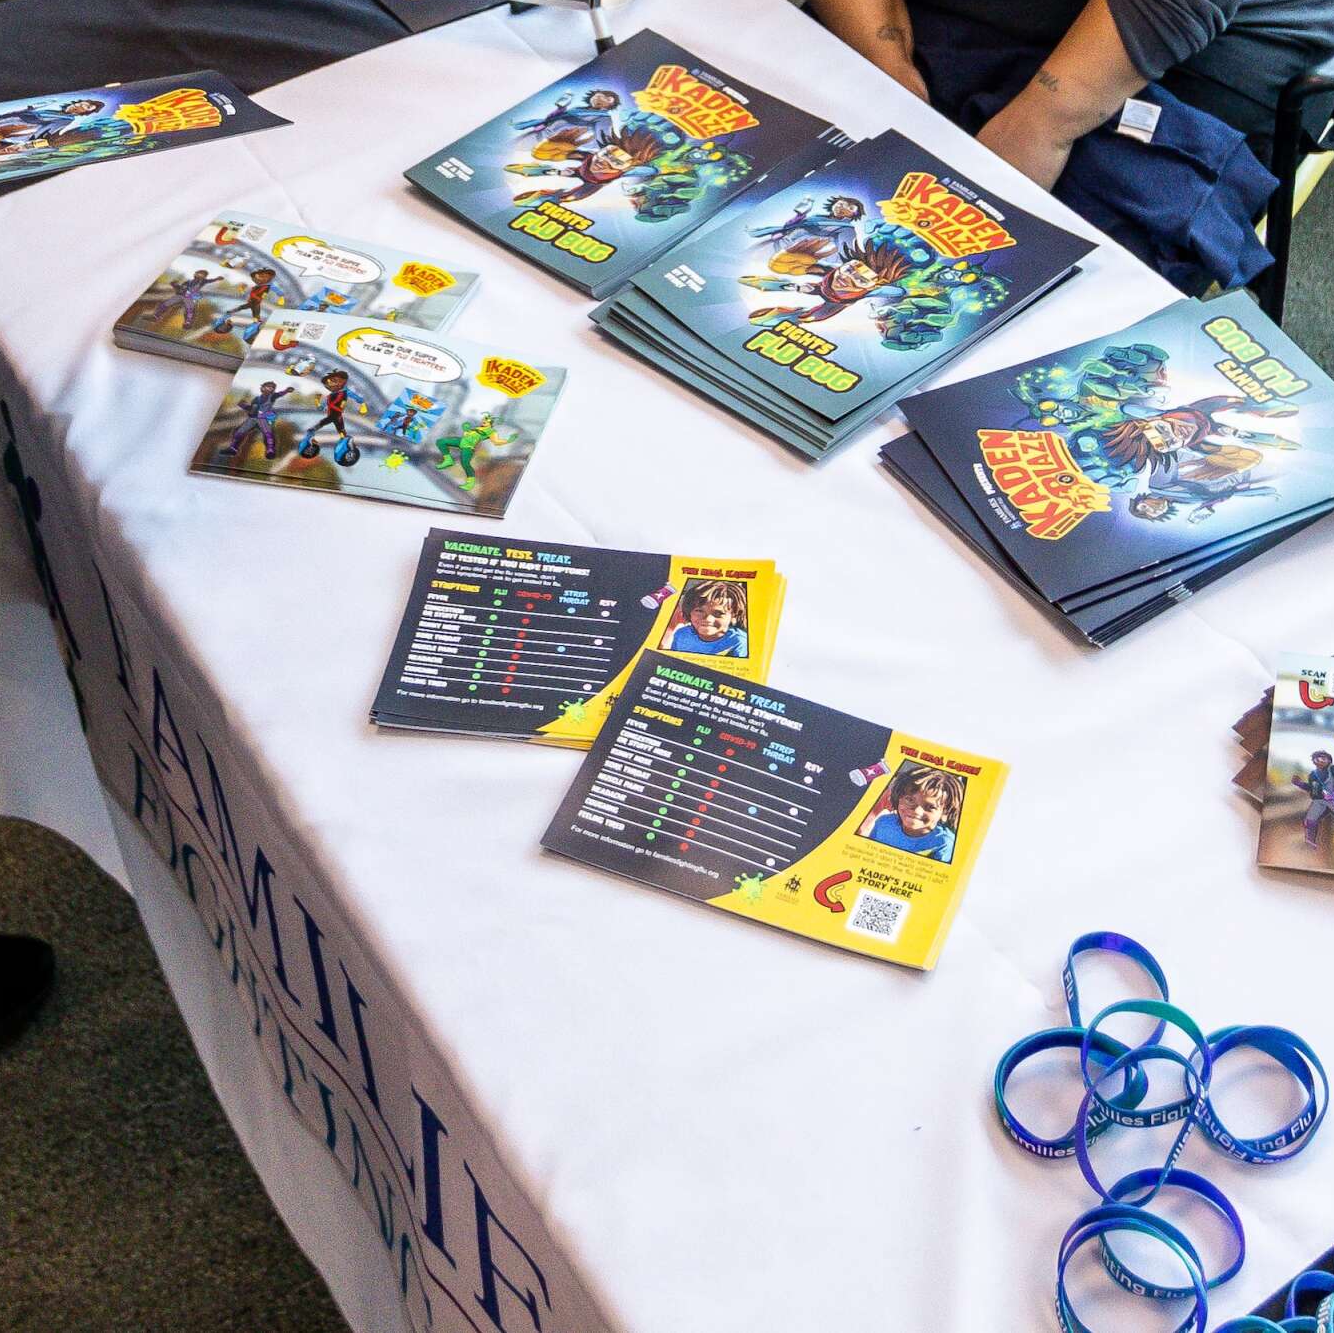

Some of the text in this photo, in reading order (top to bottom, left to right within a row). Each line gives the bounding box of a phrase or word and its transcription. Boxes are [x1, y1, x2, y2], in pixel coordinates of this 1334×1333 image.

[665, 67, 760, 132] KADEN
[670, 94, 728, 139] BLAZE
[538, 202, 594, 231] FIGHTS
[911, 175, 1015, 248] KADEN
[510, 213, 615, 262] FLU BUG
[919, 212, 985, 259] BLAZE
[408, 265, 447, 288] KADEN
[775, 322, 836, 356] FIGHTS
[1205, 318, 1308, 397] FLU BUG
[492, 360, 538, 388] KADEN
[748, 332, 860, 392] FLU BUG
[1216, 360, 1269, 403] FIGHTS
[979, 431, 1074, 536] KADEN
[1018, 431, 1079, 498] BLAZE
[445, 541, 571, 566] VACCINATE. TEST. TREAT.
[656, 665, 786, 715] VACCINATE. TEST. TREAT.
[1301, 669, 1327, 678] SCAN
[649, 677, 803, 731] GET TESTED IF YOU HAVE SYMPTOMS!
[633, 706, 683, 726] SYMPTOMS
[696, 725, 711, 734] FLU
[769, 742, 795, 756] STREP
[804, 762, 823, 774] RSV
[762, 748, 795, 765] THROAT
[855, 875, 913, 899] STORY HERE
[859, 867, 923, 892] KADEN'S FULL
[1150, 1105, 1191, 1126] Figh
[1255, 1110, 1313, 1154] ing Flu
